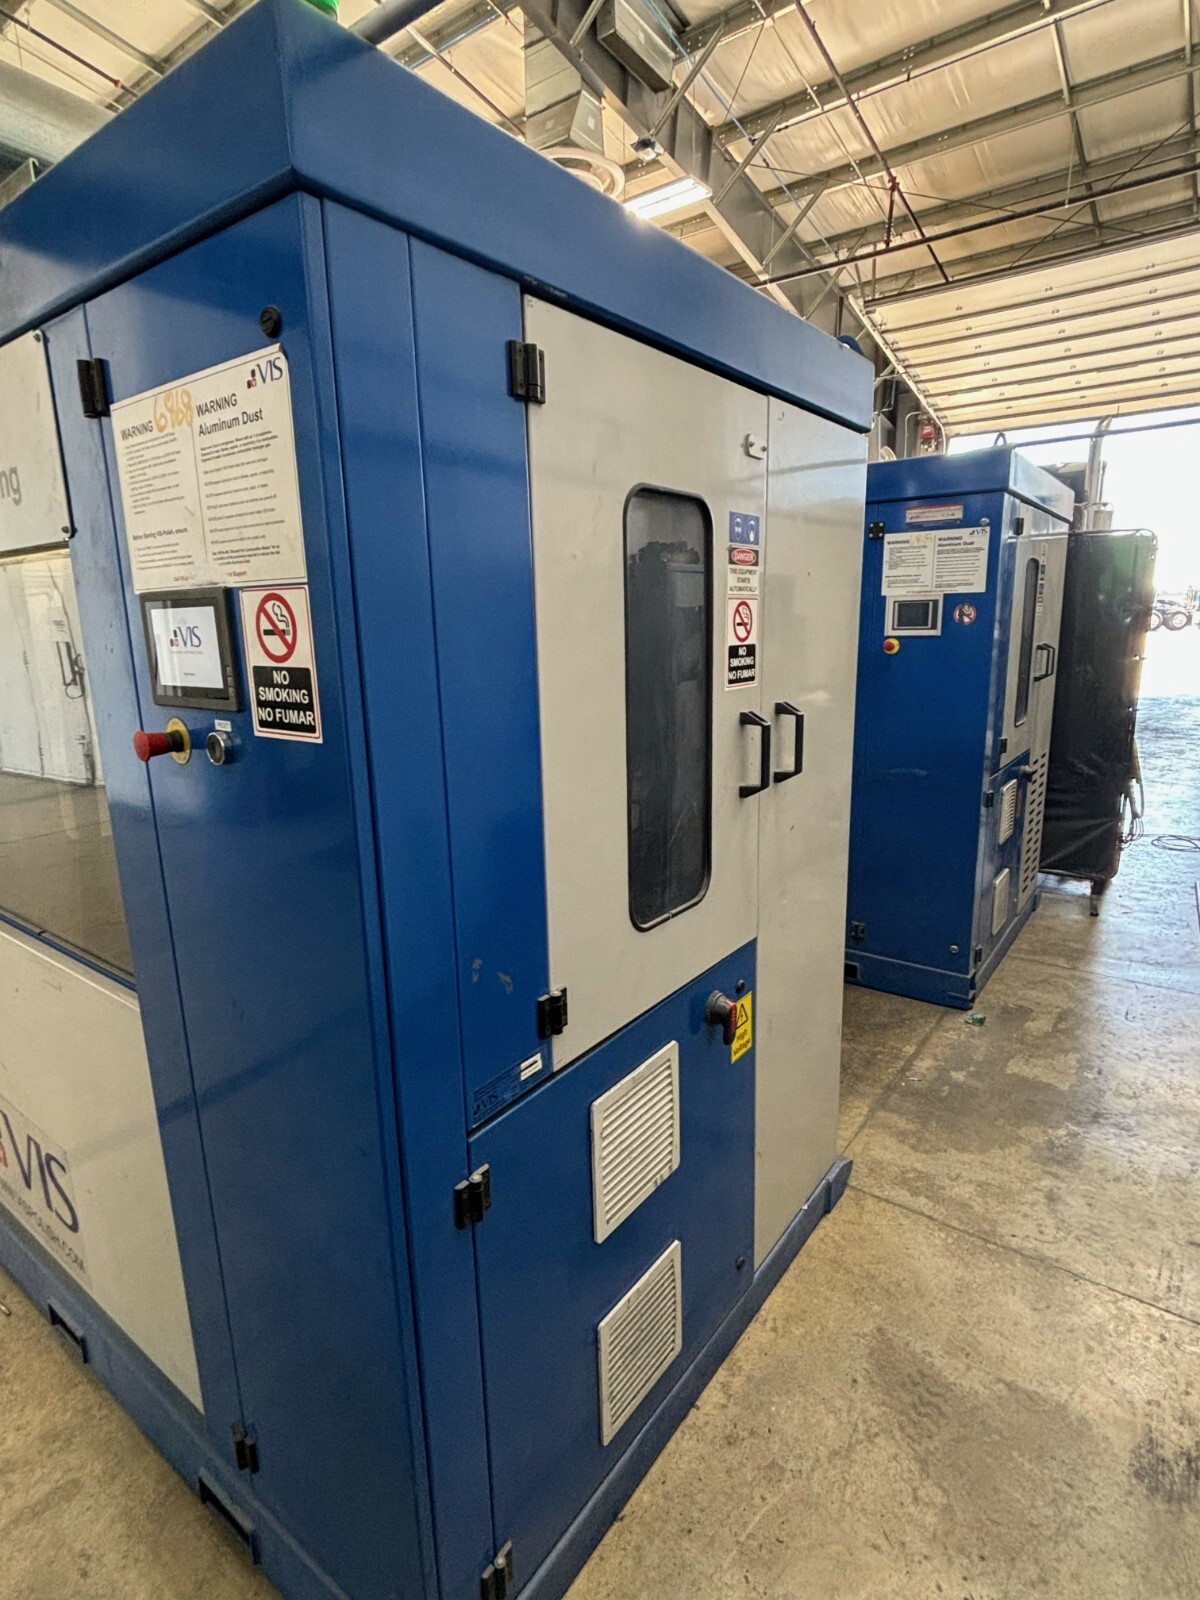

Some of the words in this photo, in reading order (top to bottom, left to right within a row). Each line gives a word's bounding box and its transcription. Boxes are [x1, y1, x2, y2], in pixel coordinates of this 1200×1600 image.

[256, 357, 283, 384] VIS
[196, 393, 238, 418] WARNING
[120, 420, 154, 441] WARNING
[198, 415, 240, 437] Aluminum
[241, 408, 264, 425] Dust
[734, 551, 754, 561] DANGER
[738, 568, 758, 576] EQUIPMENT
[176, 625, 202, 648] VIS
[738, 647, 747, 656] NO
[730, 656, 754, 667] SMOKING
[272, 670, 290, 685] NO
[728, 671, 736, 680] NO
[737, 668, 755, 679] FUMAR
[258, 686, 309, 704] SMOKING
[258, 707, 274, 721] NO
[275, 708, 315, 726] FUMAR
[0, 1109, 79, 1233] VIS
